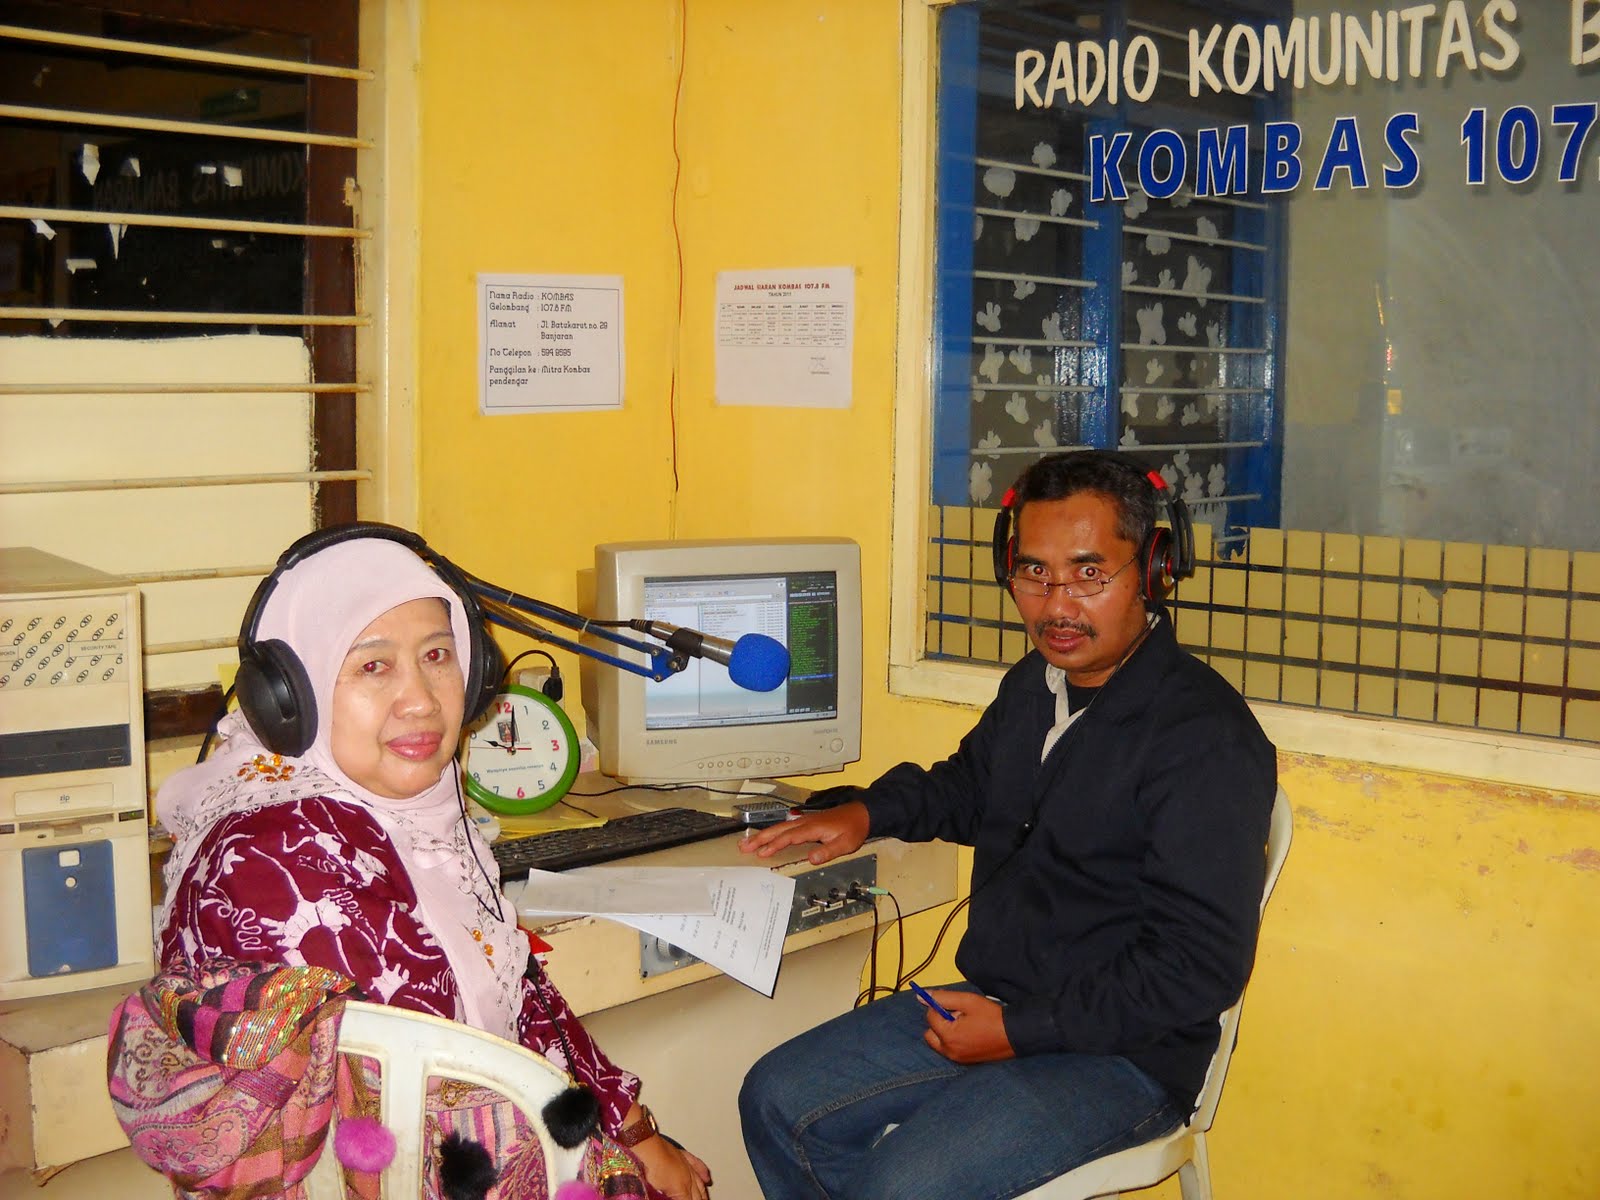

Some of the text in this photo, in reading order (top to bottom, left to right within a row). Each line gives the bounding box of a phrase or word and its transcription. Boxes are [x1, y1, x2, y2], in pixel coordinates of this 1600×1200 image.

[1015, 35, 1160, 110] RADIO
[1188, 0, 1521, 98] KOMUNITAS
[1089, 102, 1600, 202] KOMBAS 107
[489, 290, 511, 299] Nama
[512, 291, 534, 300] Radio
[541, 292, 575, 301] KOMBAS
[489, 302, 530, 313] Gelombang
[560, 304, 572, 312] FM
[489, 319, 516, 328] Alamat
[551, 320, 588, 329] Batukarut
[540, 331, 574, 342] Banjaran
[489, 348, 501, 356] No
[489, 365, 527, 375] Panggilan
[527, 365, 537, 374] ke
[541, 365, 562, 374] Mitra
[563, 365, 591, 374] Kombas
[489, 377, 529, 387] pendengar
[495, 702, 512, 714] 12
[542, 720, 550, 730] 2
[551, 740, 559, 751] 3
[550, 762, 557, 772] 4
[538, 780, 545, 790] 5
[493, 786, 500, 795] 7
[517, 787, 525, 799] 6
